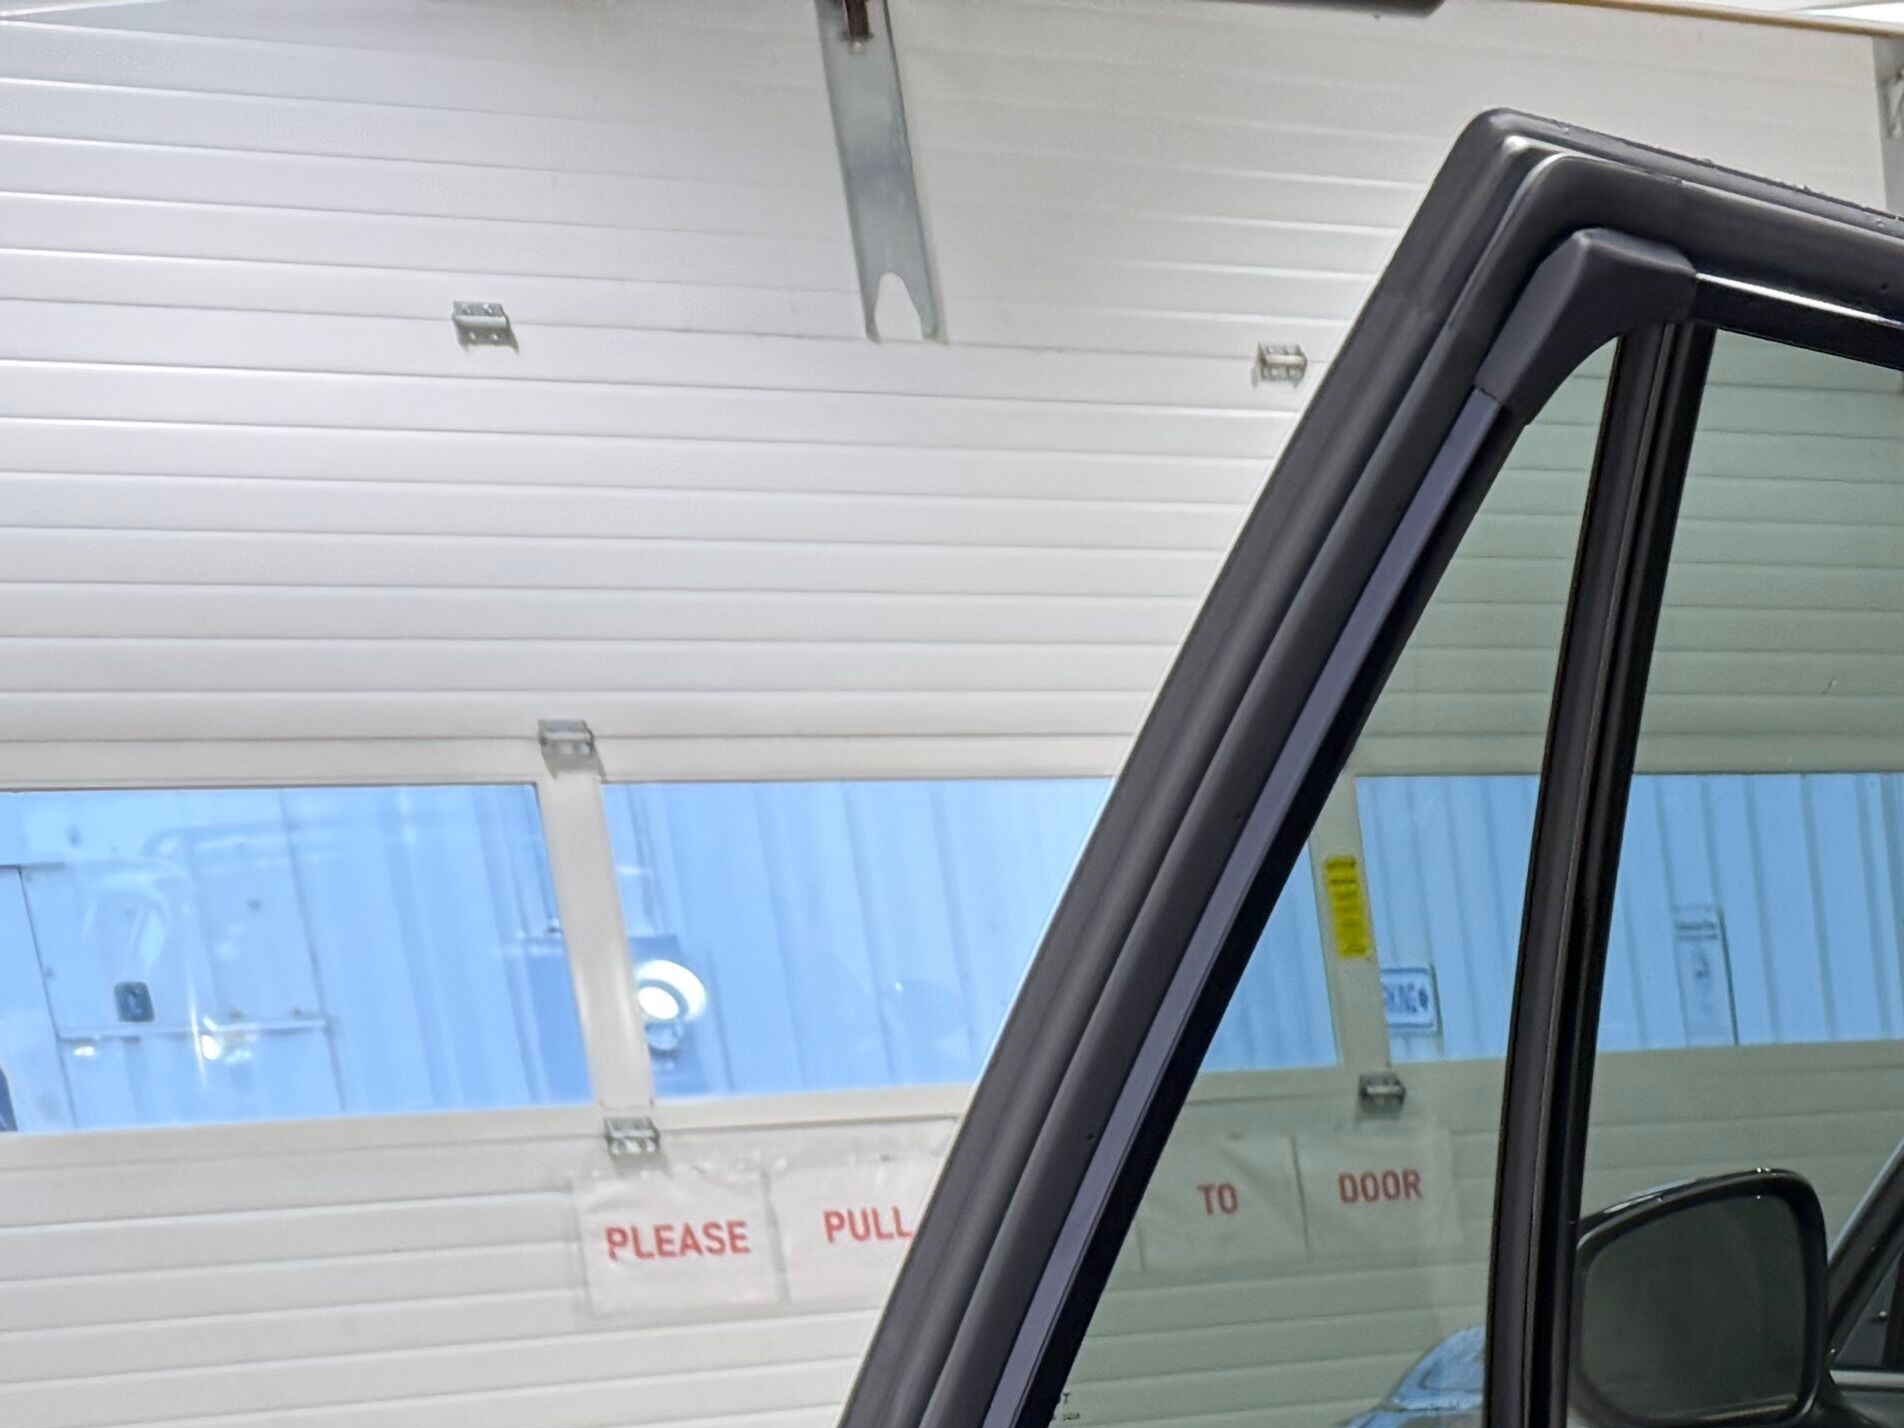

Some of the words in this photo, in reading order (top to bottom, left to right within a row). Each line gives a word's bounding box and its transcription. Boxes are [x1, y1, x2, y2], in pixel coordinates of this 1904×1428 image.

[604, 1219, 751, 1261] PLEASE
[823, 1205, 913, 1244] PULL
[1198, 1182, 1239, 1215] TO
[1338, 1168, 1423, 1205] DOOR
